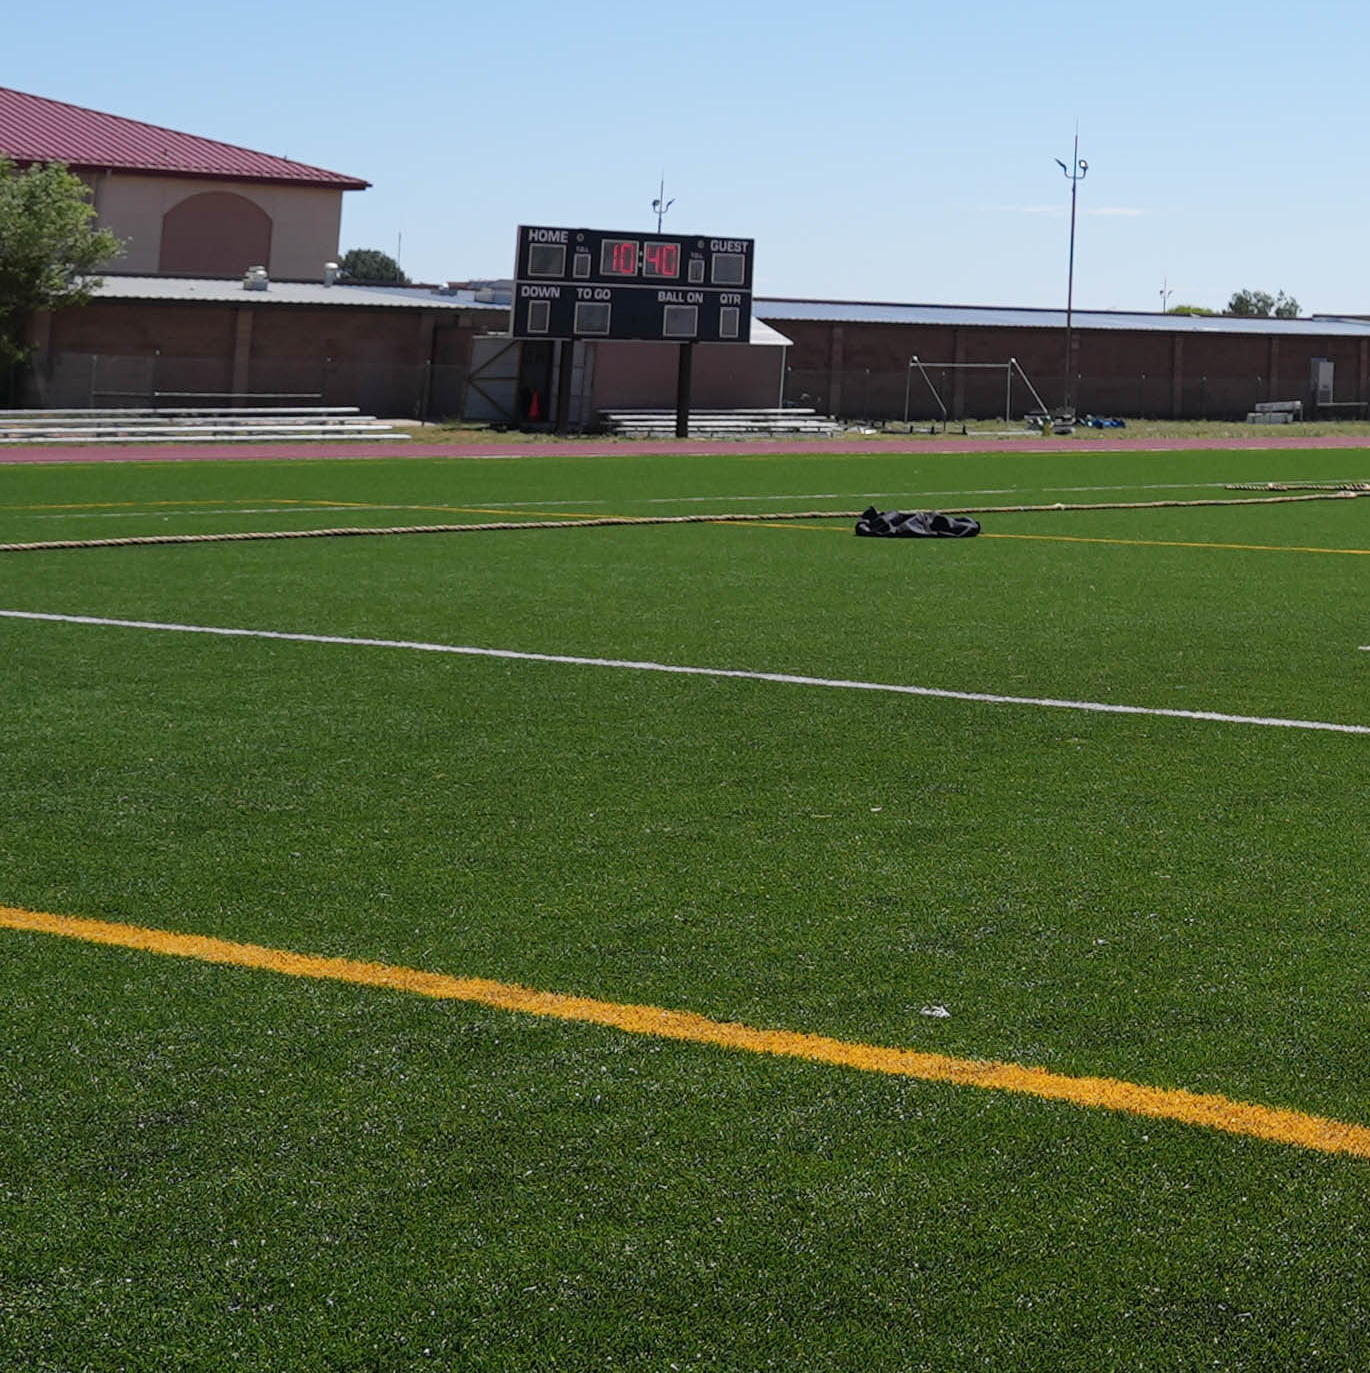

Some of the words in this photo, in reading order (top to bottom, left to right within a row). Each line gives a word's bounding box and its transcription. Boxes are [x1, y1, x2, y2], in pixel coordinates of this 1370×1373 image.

[528, 229, 569, 243] HOME
[710, 239, 749, 253] GUEST
[521, 285, 561, 298] DOWN
[576, 288, 592, 299] TO
[594, 288, 611, 300] GO
[658, 291, 685, 303] BALL
[687, 291, 703, 303] ON
[720, 293, 741, 304] QTR
